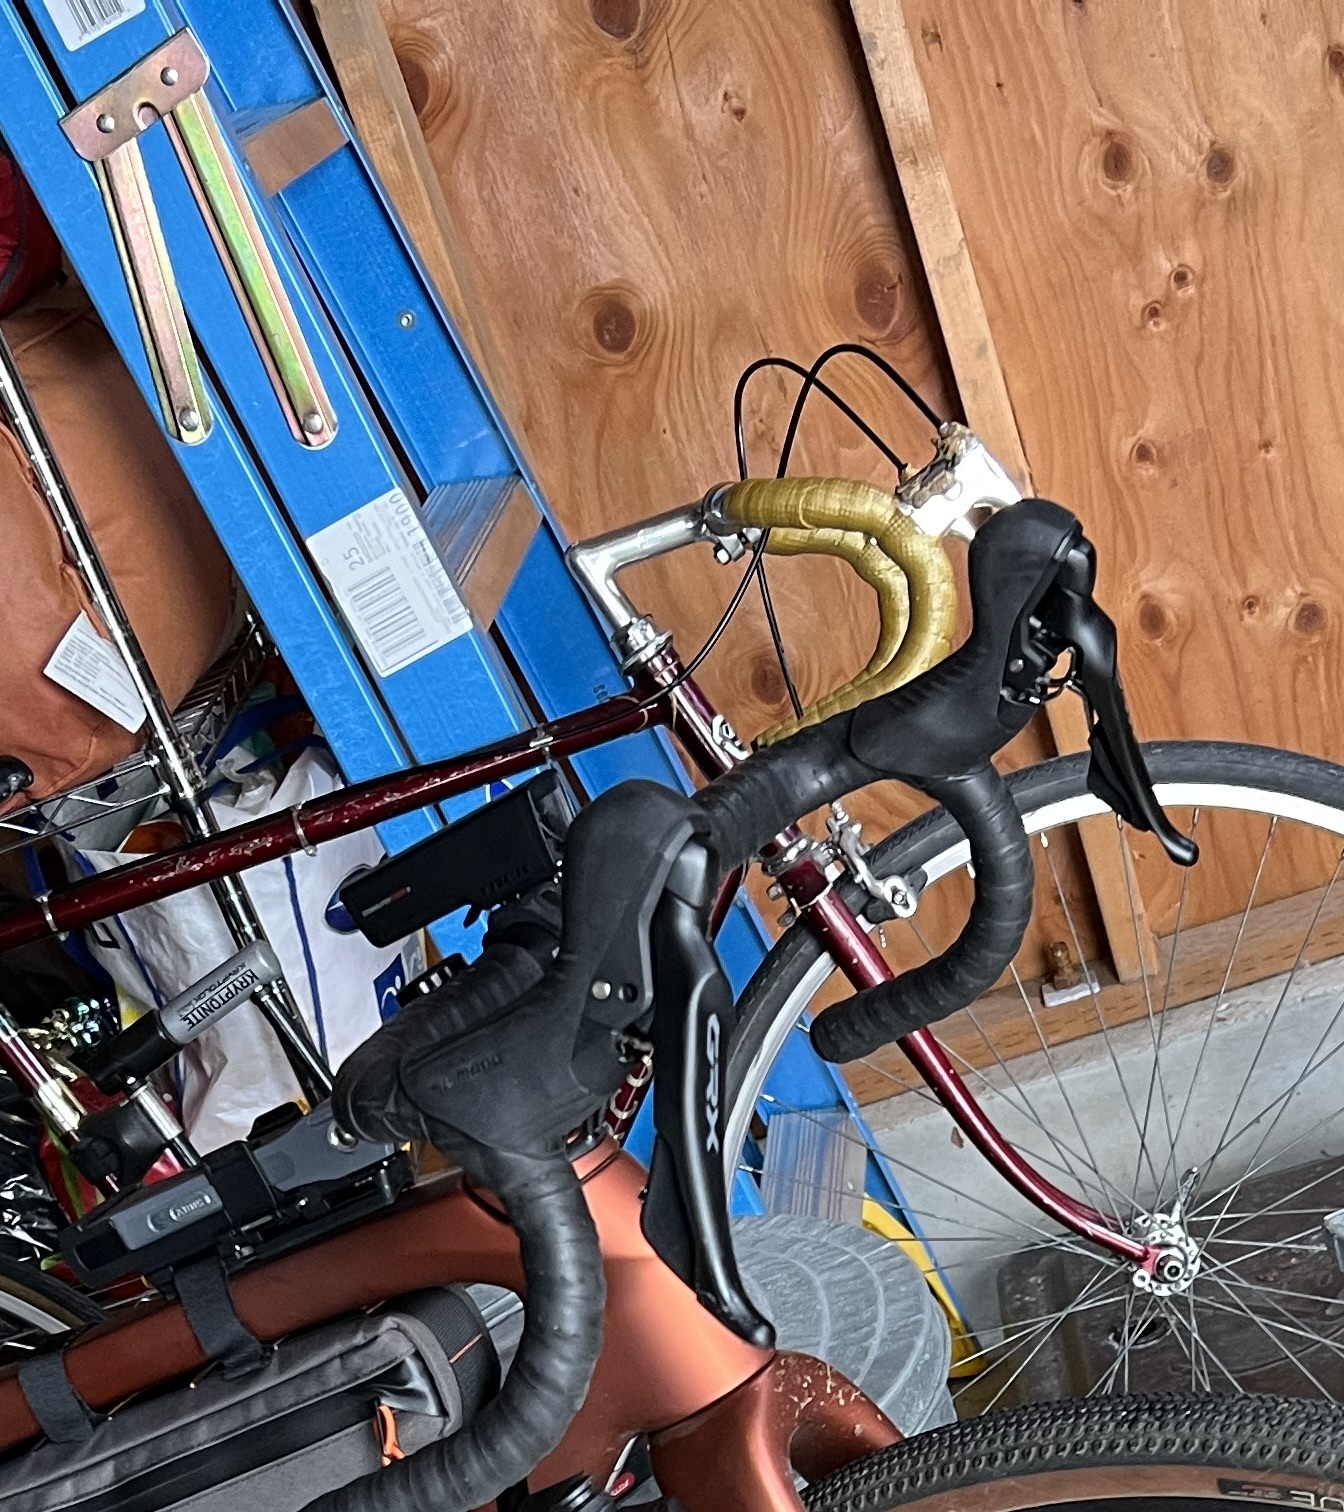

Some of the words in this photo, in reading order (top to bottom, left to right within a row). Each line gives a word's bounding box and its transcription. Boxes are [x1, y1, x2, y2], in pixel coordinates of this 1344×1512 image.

[342, 546, 365, 571] 25
[180, 969, 259, 1031] KRYPTONITE
[705, 1012, 722, 1154] GRX
